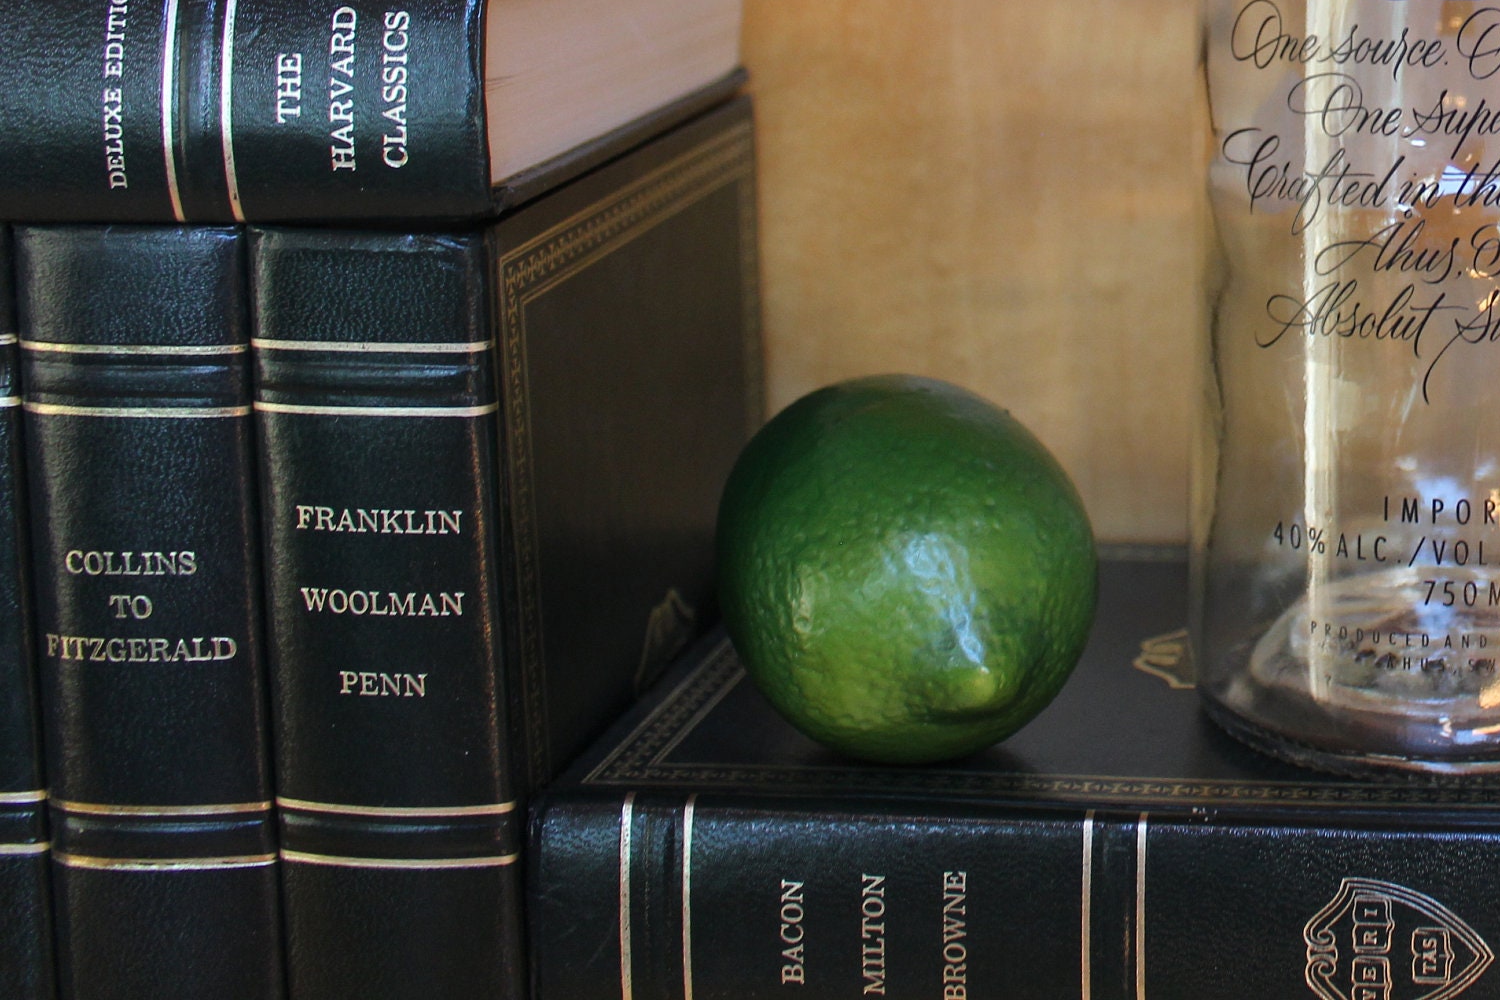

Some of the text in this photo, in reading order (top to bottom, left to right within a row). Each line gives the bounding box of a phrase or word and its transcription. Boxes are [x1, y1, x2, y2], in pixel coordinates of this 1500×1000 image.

[1319, 24, 1449, 82] source.
[277, 53, 302, 123] THE
[332, 6, 358, 171] HARVARD
[382, 10, 411, 169] CLASSICS
[1288, 72, 1402, 137] One
[104, 87, 128, 189] DELUXE
[1223, 128, 1404, 236] Crafted
[1399, 172, 1444, 209] in
[1255, 281, 1467, 358] Absolut
[296, 505, 463, 535] FRANKLIN
[1274, 521, 1325, 554] 40%
[65, 550, 198, 576] COLLINS
[109, 595, 153, 619] TO
[300, 587, 465, 617] WOOLMAN
[46, 633, 238, 663] FITZGERALD
[1310, 620, 1430, 647] PRODUCED
[1444, 633, 1488, 649] AND
[339, 670, 429, 698] PENN
[780, 878, 805, 985] BACON
[861, 873, 886, 996] MILTON
[943, 871, 967, 1000] BROWNE
[1422, 938, 1438, 975] TAS
